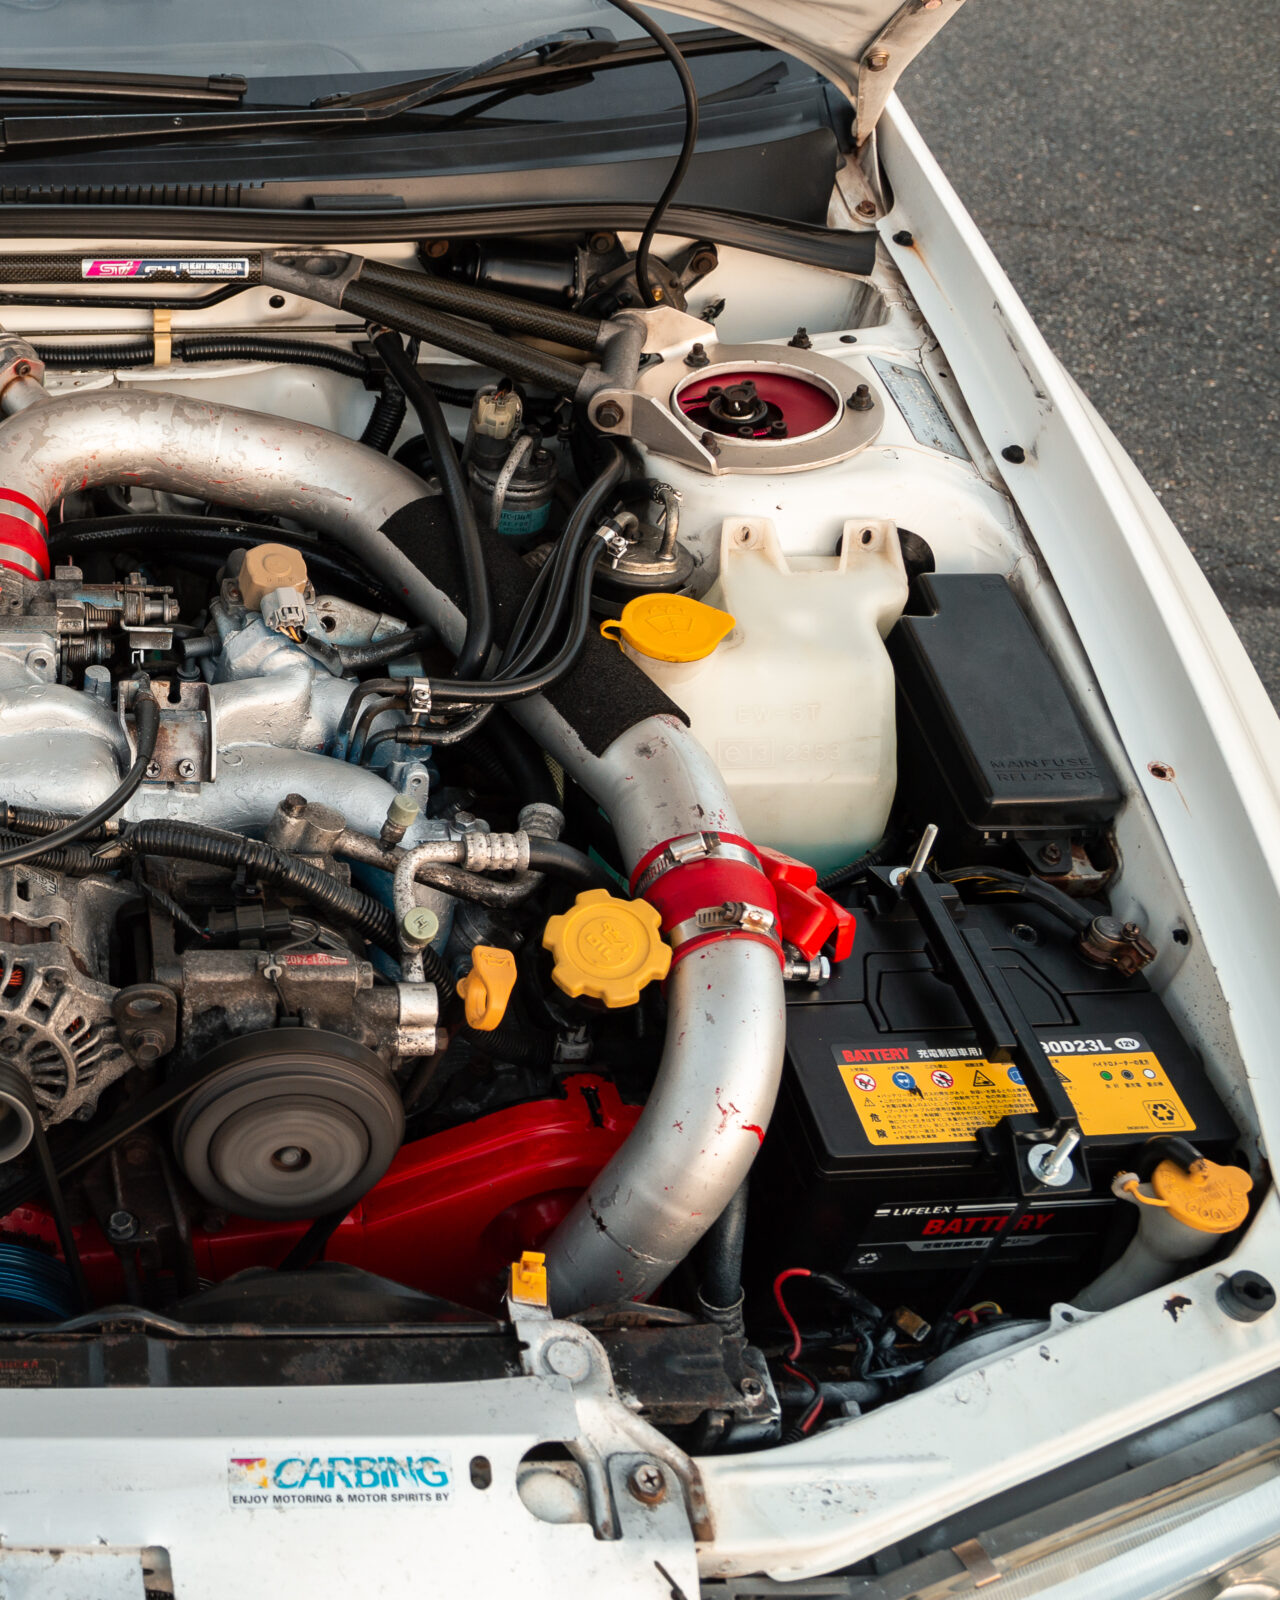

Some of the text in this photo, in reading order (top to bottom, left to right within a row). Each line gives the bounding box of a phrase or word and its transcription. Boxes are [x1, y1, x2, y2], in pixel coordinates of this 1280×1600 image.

[996, 771, 1100, 782] RELAY BOX
[585, 934, 611, 961] OIL
[1120, 1040, 1137, 1049] 12V
[842, 1047, 909, 1063] BATTERY
[893, 1206, 953, 1217] LIFELEX
[273, 1456, 449, 1489] CARBING
[232, 1492, 450, 1505] ENJOY MOTORING & MOTOR SPIRITS BY
